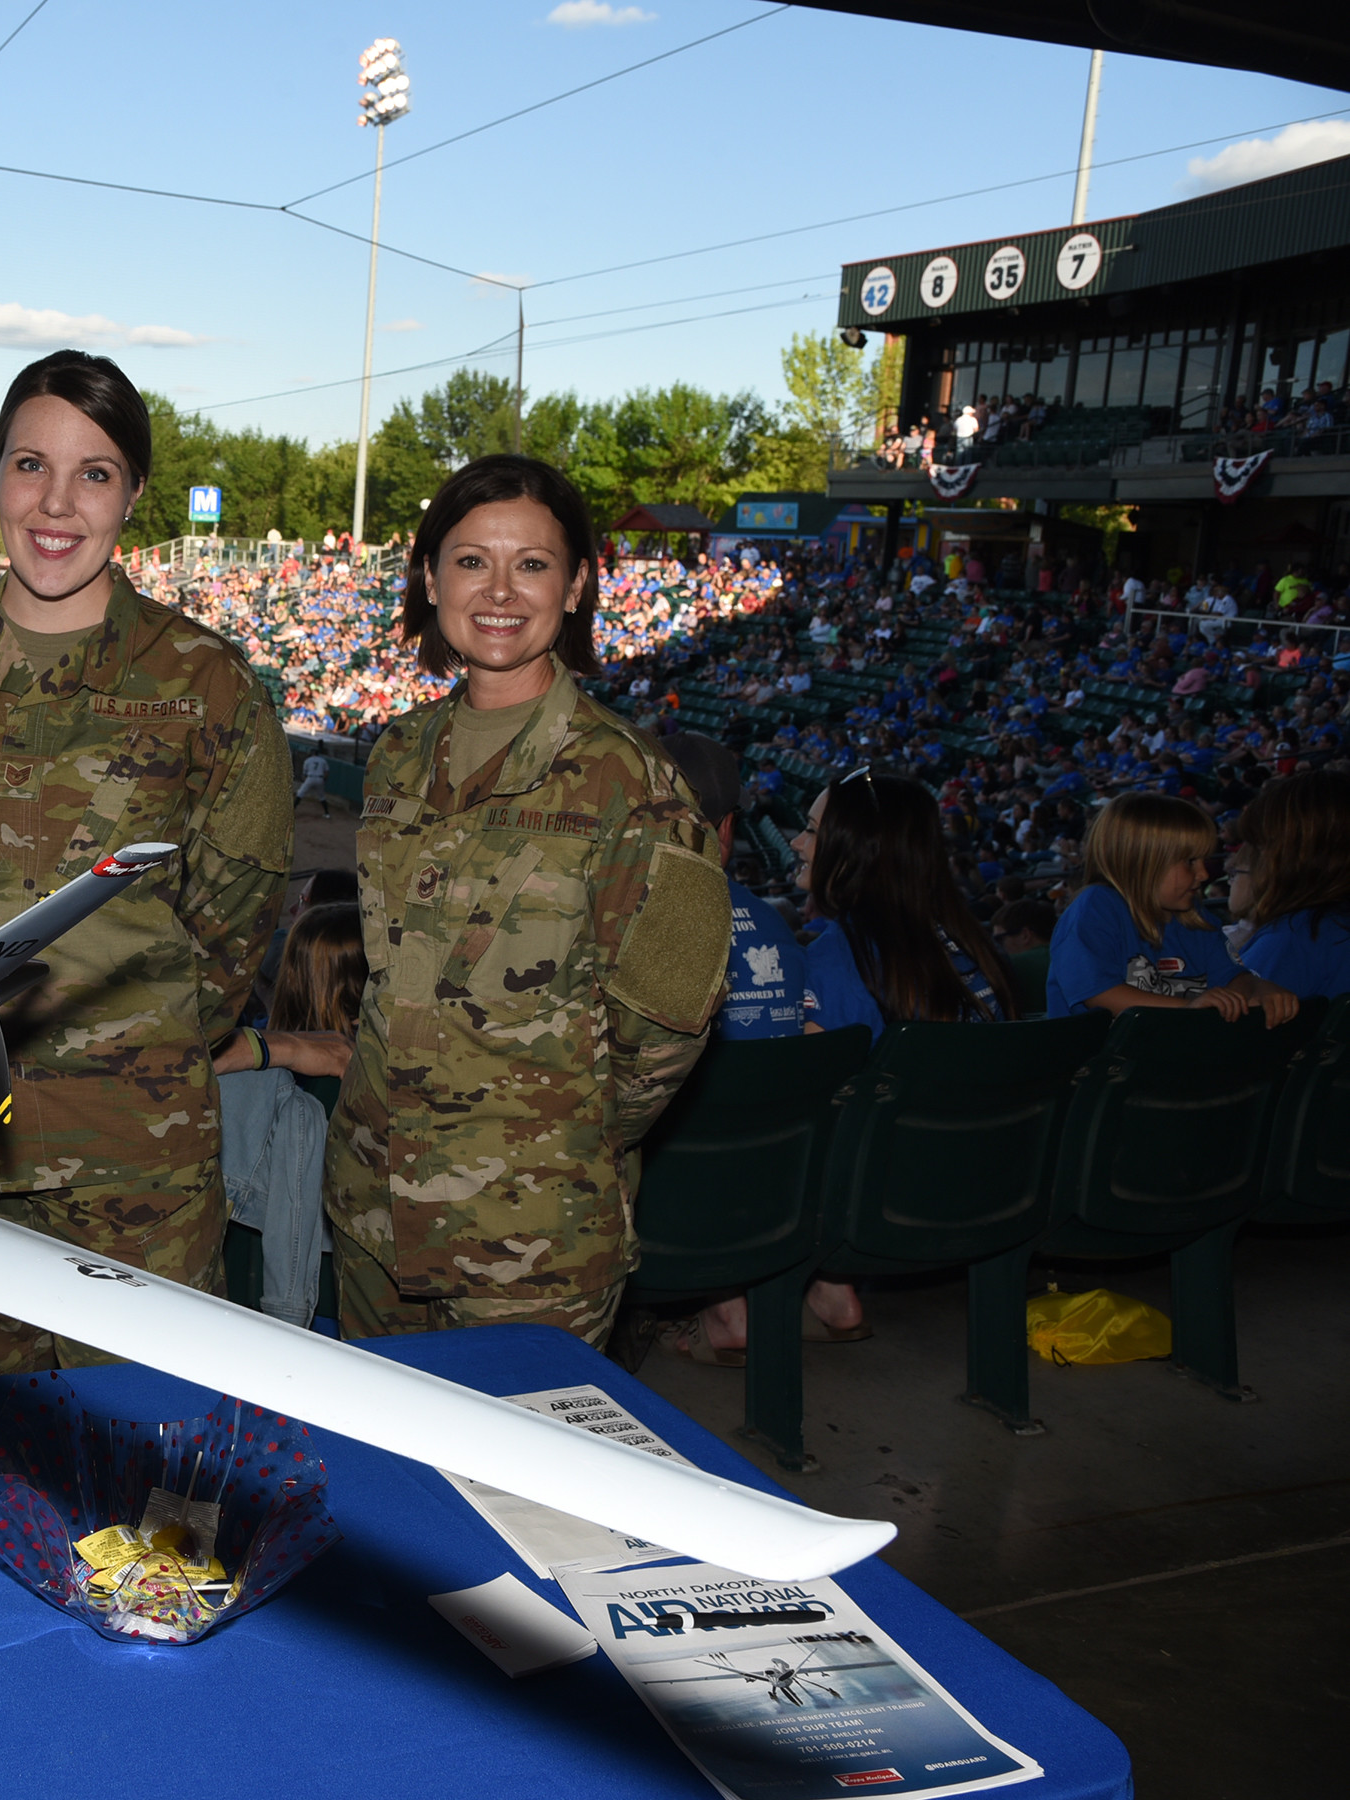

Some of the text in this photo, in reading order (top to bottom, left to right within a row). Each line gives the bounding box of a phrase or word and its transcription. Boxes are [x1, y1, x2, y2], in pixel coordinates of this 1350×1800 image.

[990, 264, 1019, 290] 35
[1071, 254, 1085, 280] 7
[864, 284, 889, 308] 42
[932, 275, 944, 298] 8
[194, 489, 217, 512] M
[94, 698, 198, 717] U.S. AIR FORCE
[488, 807, 594, 837] U.S. AIR FORCE
[725, 989, 786, 1002] PONSORED BY
[550, 1401, 575, 1412] AIR
[565, 1413, 591, 1424] AIR
[618, 1579, 764, 1600] NORTH DAKOTA
[695, 1586, 816, 1609] NATIONAL
[759, 1717, 797, 1727] AMAZING
[796, 1713, 840, 1722] BENEFITS,
[840, 1706, 887, 1717] EXCELLENT
[887, 1701, 926, 1711] TRAINING
[775, 1719, 865, 1735] JOIN OUR TEAM!
[831, 1730, 863, 1739] SHELLY
[863, 1727, 885, 1735] FINK
[797, 1738, 877, 1754] 701-500-0214
[924, 1755, 988, 1771] @NDAIRGUARD
